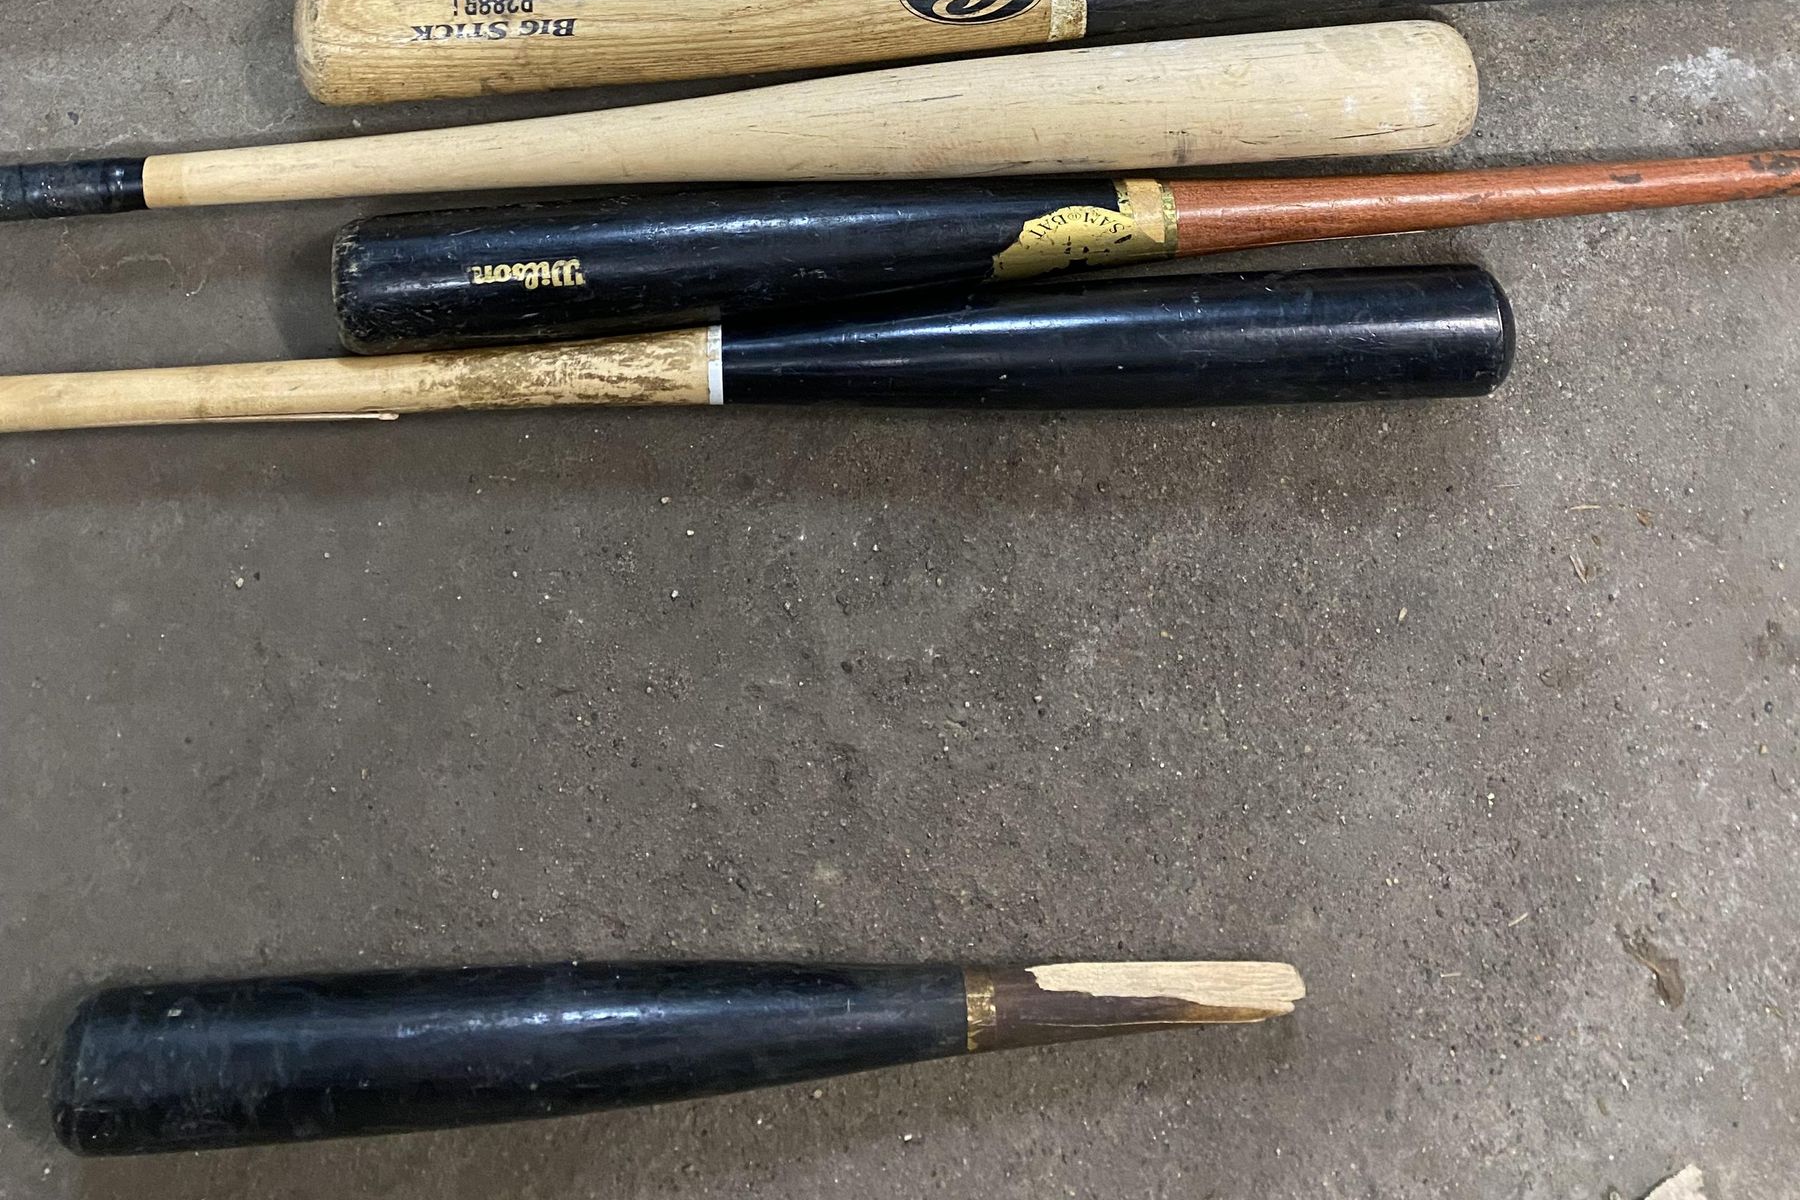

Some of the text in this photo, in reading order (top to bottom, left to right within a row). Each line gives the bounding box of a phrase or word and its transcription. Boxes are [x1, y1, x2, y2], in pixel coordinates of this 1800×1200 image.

[410, 18, 579, 42] BIG STICK
[1028, 211, 1125, 239] SAM BAT
[470, 258, 587, 290] Wilson
